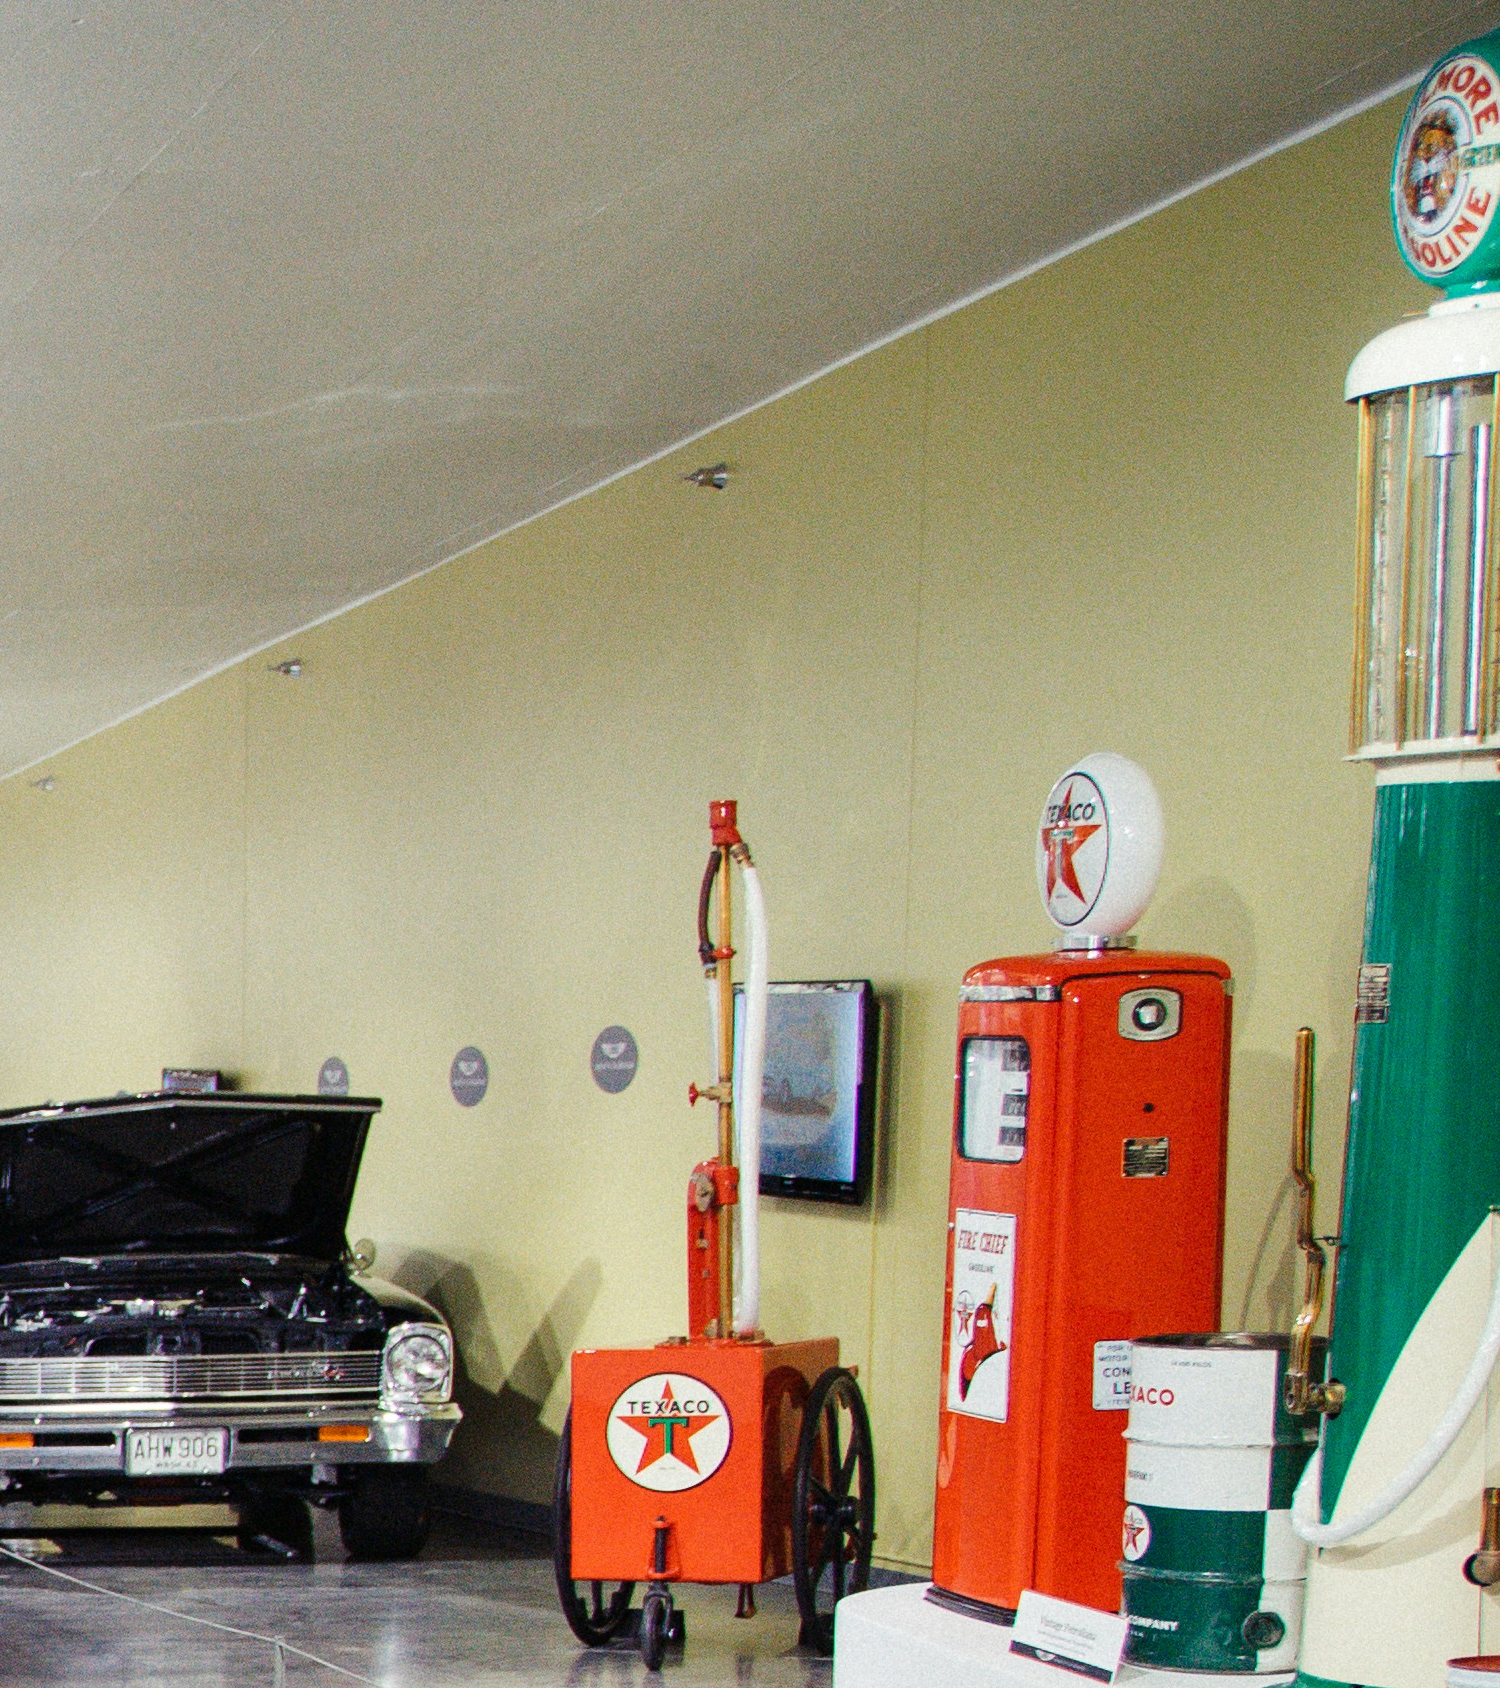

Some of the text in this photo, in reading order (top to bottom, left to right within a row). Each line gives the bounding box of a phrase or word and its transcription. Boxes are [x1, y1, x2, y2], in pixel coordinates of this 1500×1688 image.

[1048, 802, 1097, 825] TEXACO
[957, 1229, 1009, 1255] FIRE CHIEF
[626, 1399, 710, 1415] TEXACO
[135, 1436, 218, 1459] AHW 906
